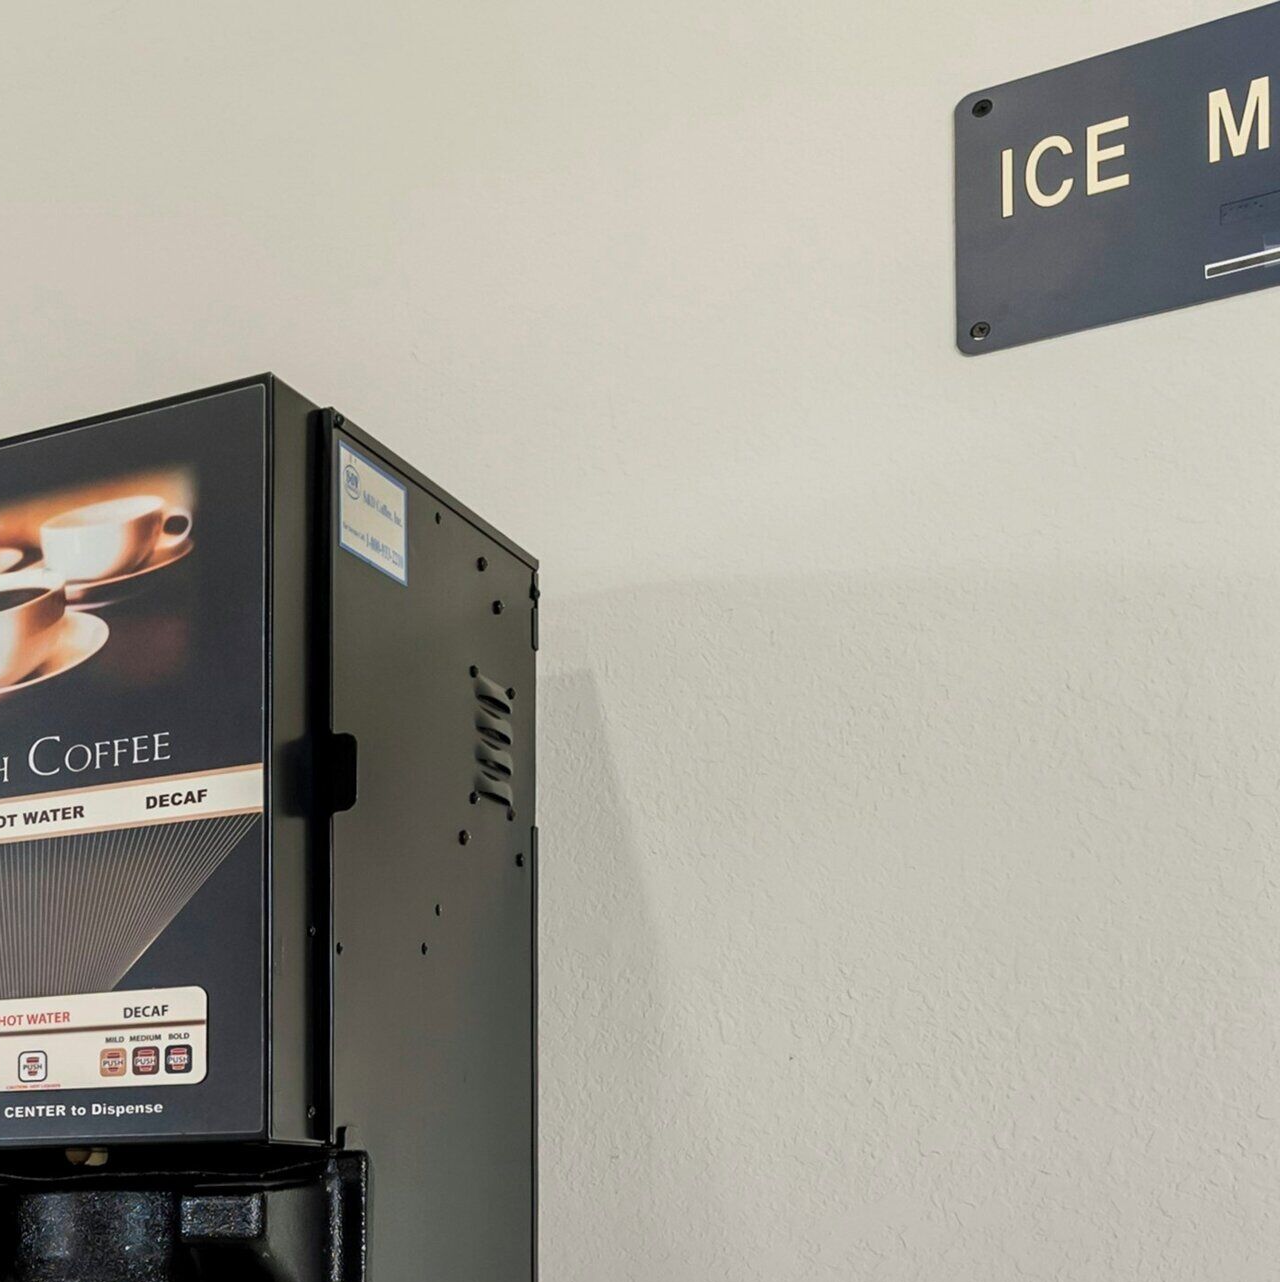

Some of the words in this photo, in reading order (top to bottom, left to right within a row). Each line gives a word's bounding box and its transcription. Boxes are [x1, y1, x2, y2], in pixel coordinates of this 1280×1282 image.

[1001, 115, 1130, 218] ICE
[22, 805, 85, 825] WATER
[145, 789, 208, 810] DECAF
[26, 1011, 70, 1025] WATER
[123, 1005, 169, 1018] DECAF
[129, 1034, 162, 1042] MEDIUM
[168, 1032, 190, 1040] BOLD
[4, 1105, 66, 1118] CENTER
[71, 1105, 86, 1116] to
[91, 1102, 164, 1119] Dispense
